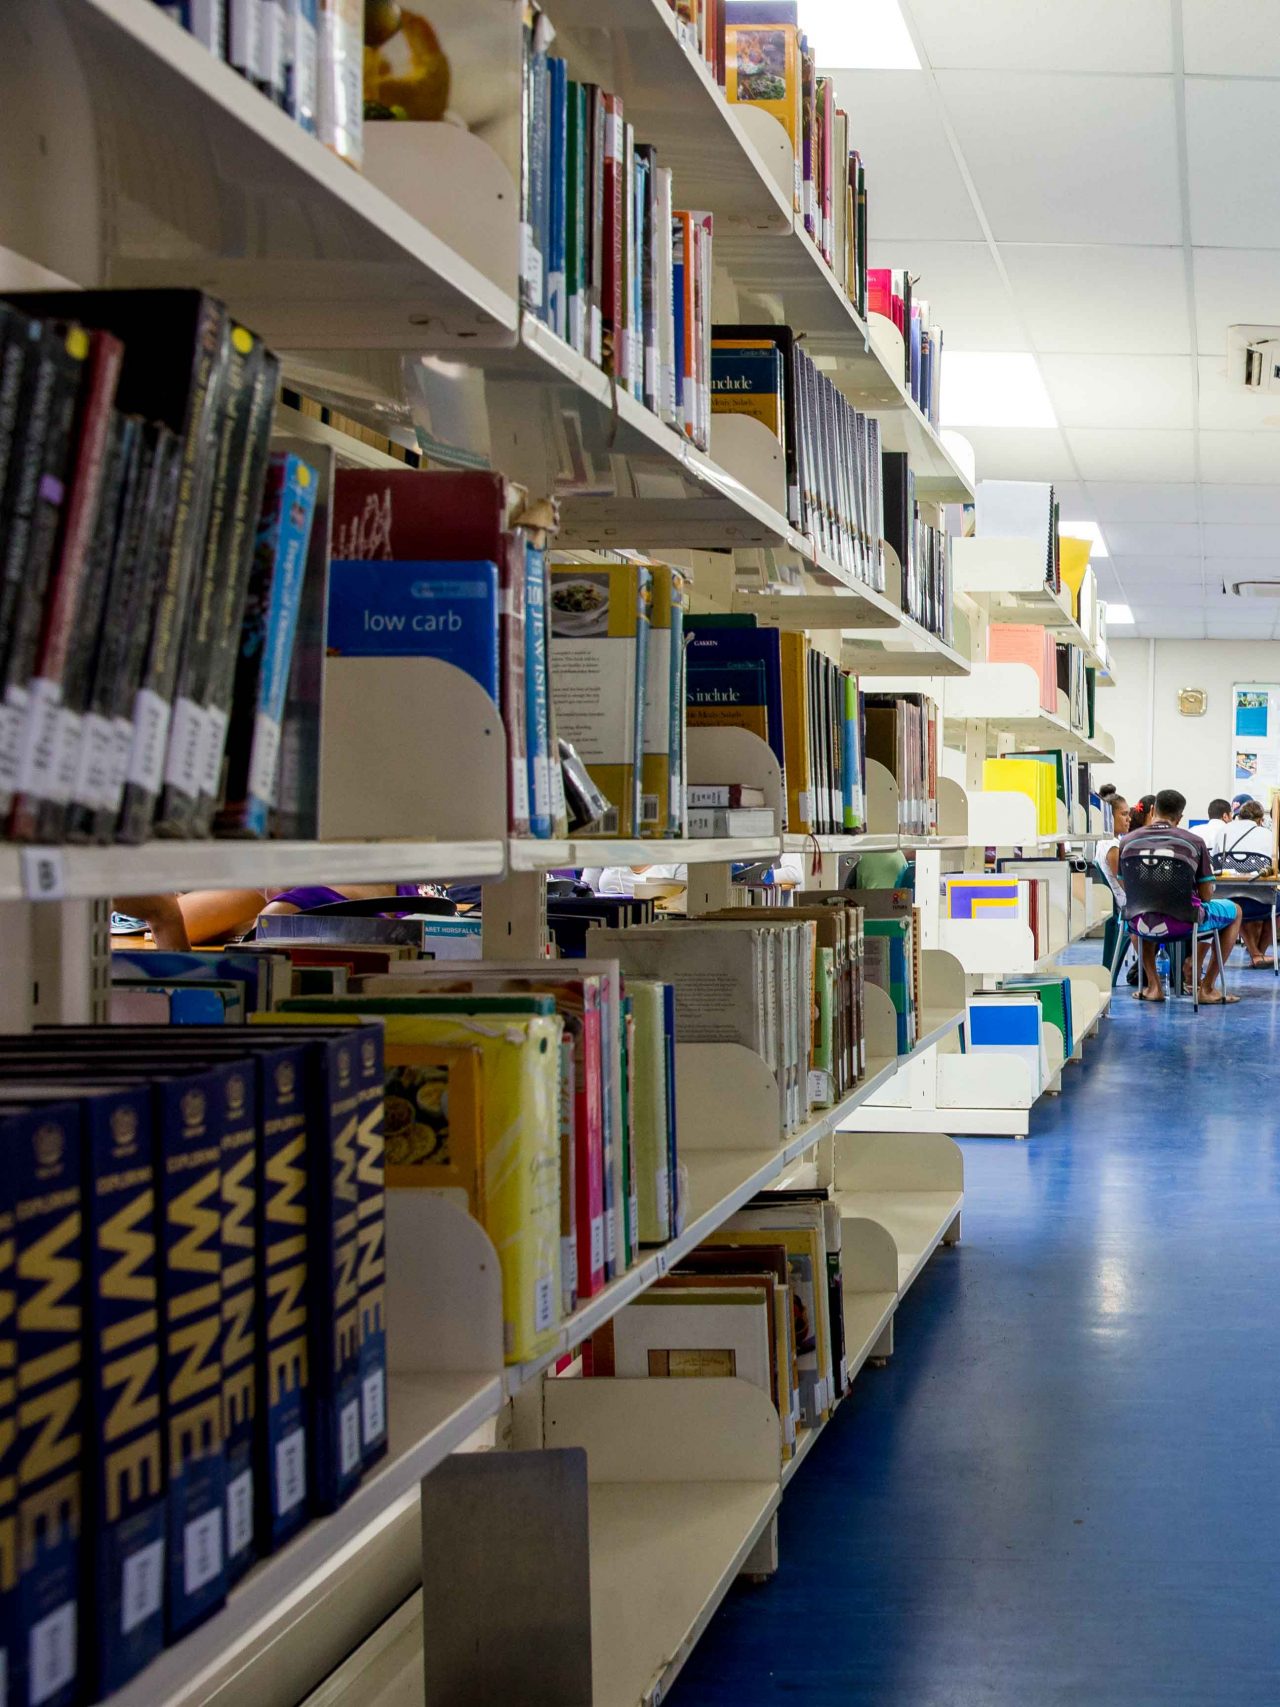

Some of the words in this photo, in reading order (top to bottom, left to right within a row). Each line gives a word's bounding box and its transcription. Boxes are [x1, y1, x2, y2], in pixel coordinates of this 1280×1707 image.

[614, 281, 623, 330] FOOD
[710, 375, 753, 390] nclude
[364, 609, 406, 632] low
[412, 609, 463, 632] carb
[532, 608, 546, 702] JEWISH
[696, 688, 741, 702] include
[167, 1167, 221, 1479] WINE
[221, 1148, 256, 1439] WINE
[265, 1131, 308, 1408] WINE
[333, 1113, 360, 1374] WINE
[357, 1101, 385, 1345] WINE
[17, 1209, 82, 1573] WINE
[98, 1186, 161, 1523] WINE
